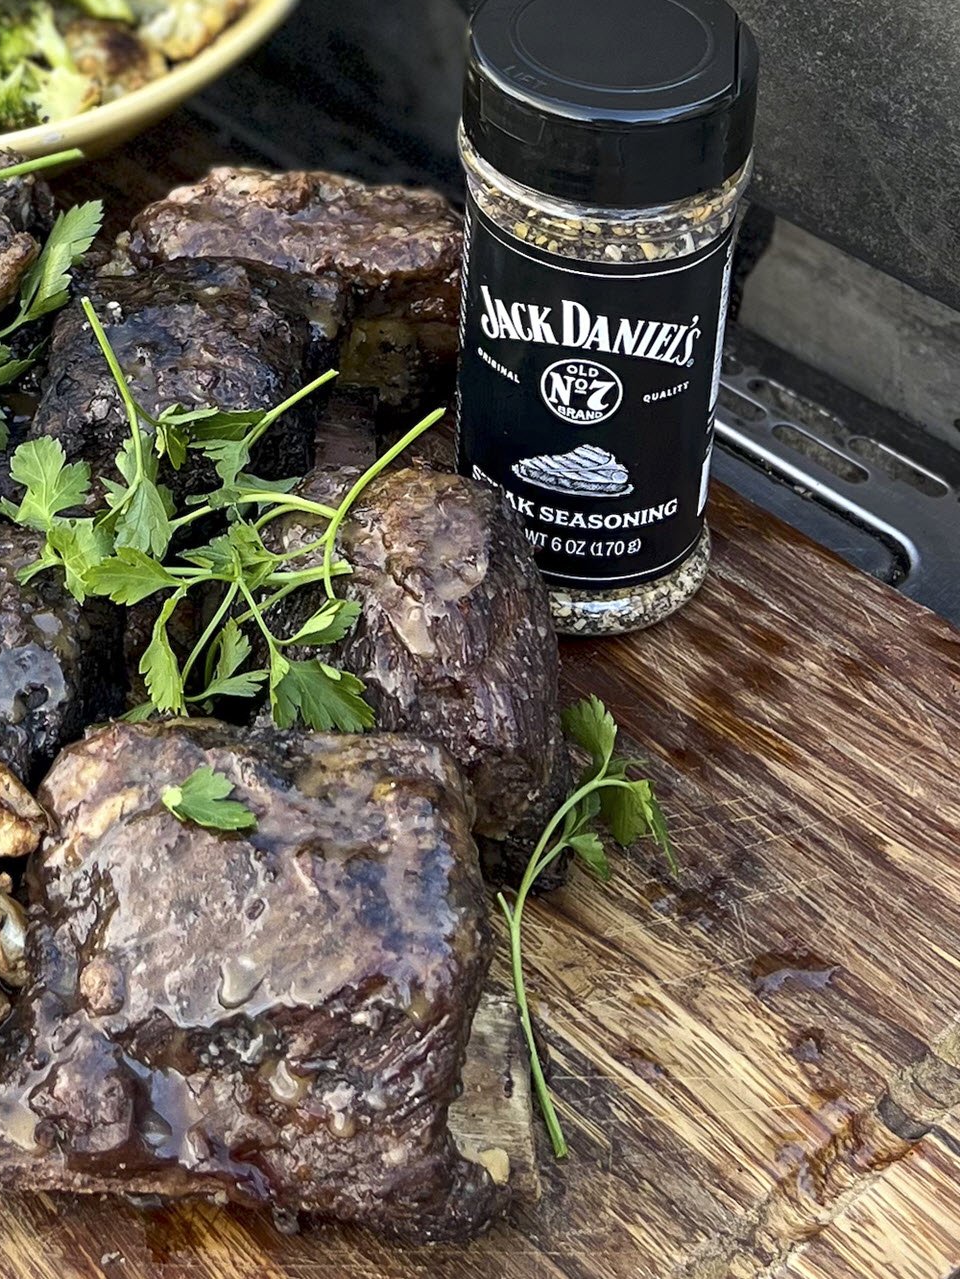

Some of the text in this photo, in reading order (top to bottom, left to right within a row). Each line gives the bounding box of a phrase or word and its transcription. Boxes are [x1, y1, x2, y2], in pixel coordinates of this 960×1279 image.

[480, 285, 701, 366] JACK DANIEL'S
[477, 346, 521, 384] ORIGINAL
[566, 364, 599, 378] OLD
[643, 380, 690, 404] QUALITY
[557, 405, 604, 420] BRAND
[539, 498, 679, 530] SEASONING
[525, 528, 548, 548] WT
[551, 536, 562, 553] 6
[565, 539, 586, 556] OZ
